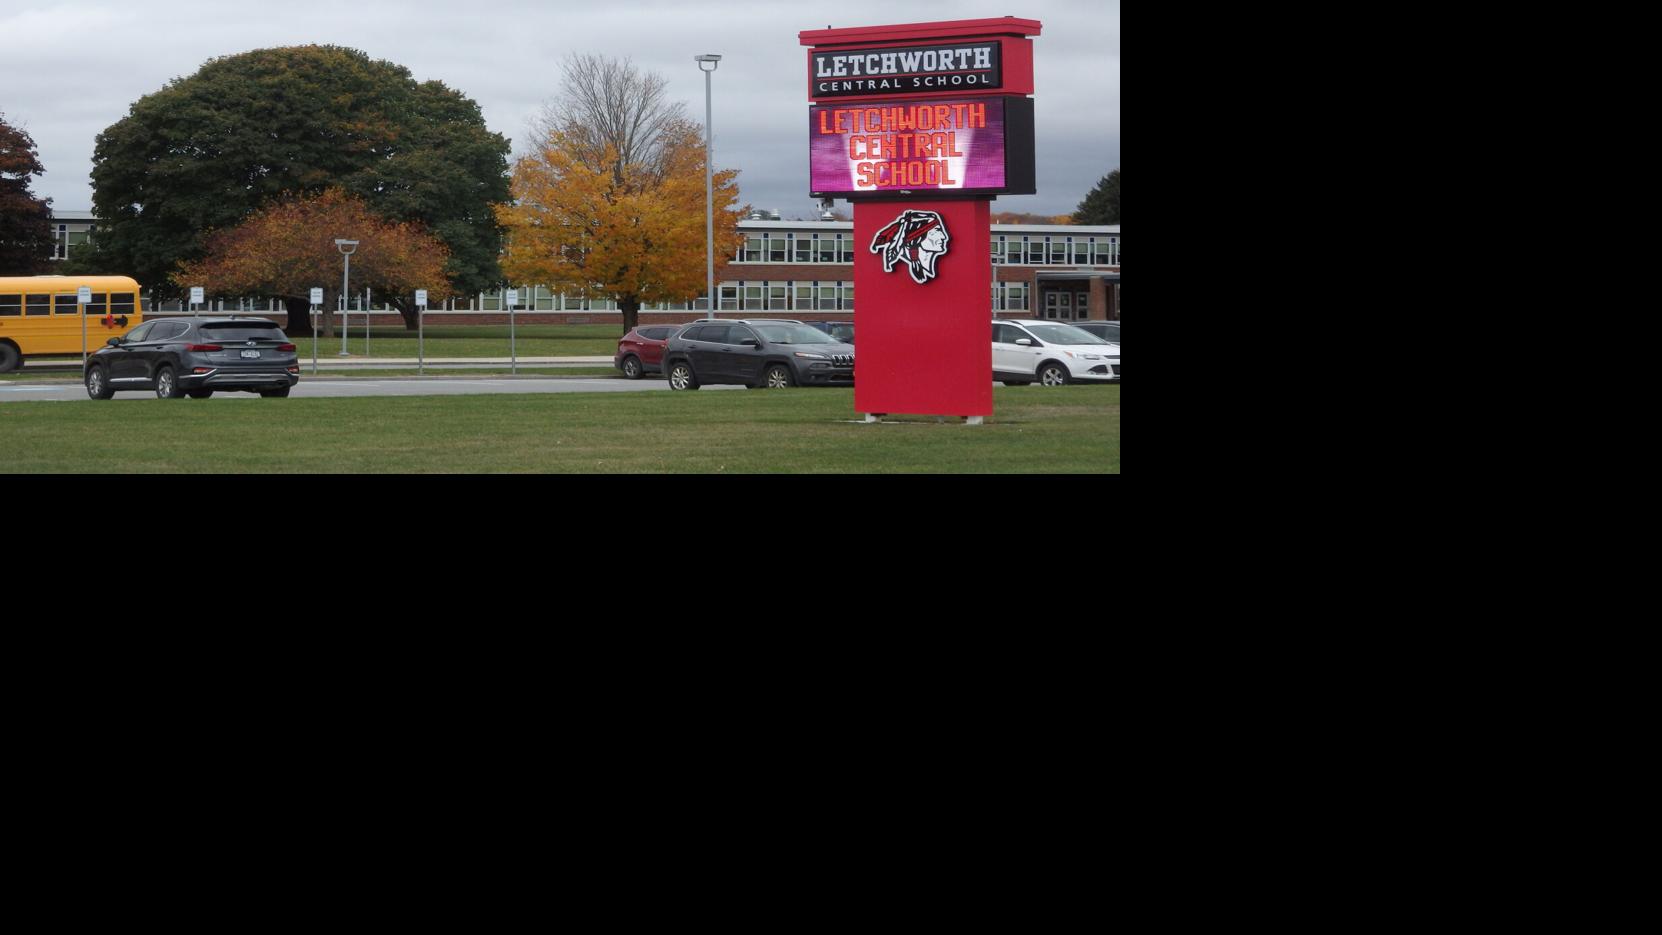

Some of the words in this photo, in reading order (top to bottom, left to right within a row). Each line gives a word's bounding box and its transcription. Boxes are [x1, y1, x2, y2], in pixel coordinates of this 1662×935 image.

[817, 47, 991, 77] LETCHWORTH
[819, 78, 901, 92] CENTRAL
[913, 74, 989, 87] SCHOOL
[819, 103, 986, 134] LETCHWORTH
[849, 132, 962, 161] CENTRAL
[857, 160, 956, 187] SCHOOL
